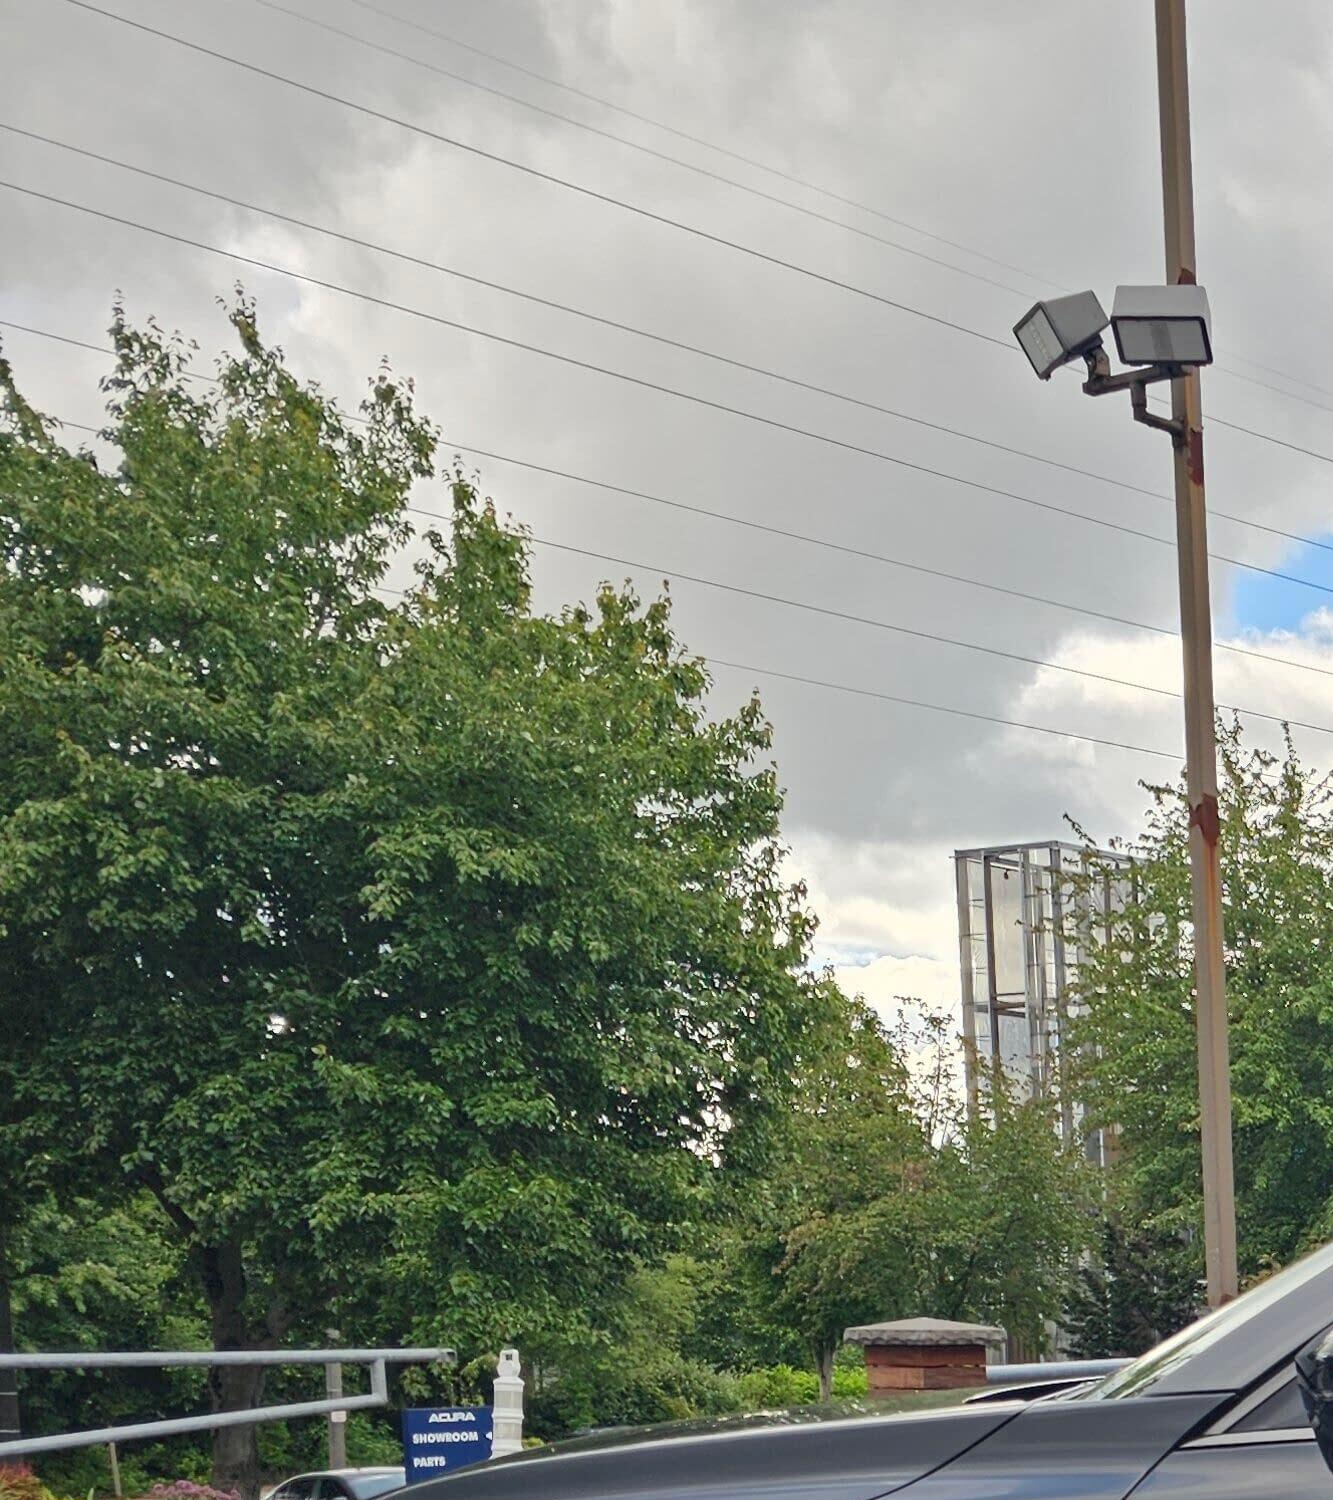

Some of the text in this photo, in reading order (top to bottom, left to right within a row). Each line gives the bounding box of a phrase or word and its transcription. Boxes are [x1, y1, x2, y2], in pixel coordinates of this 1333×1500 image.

[428, 1412, 476, 1423] ACURA
[412, 1431, 479, 1444] SHOWROOM
[413, 1456, 446, 1468] PARTS
